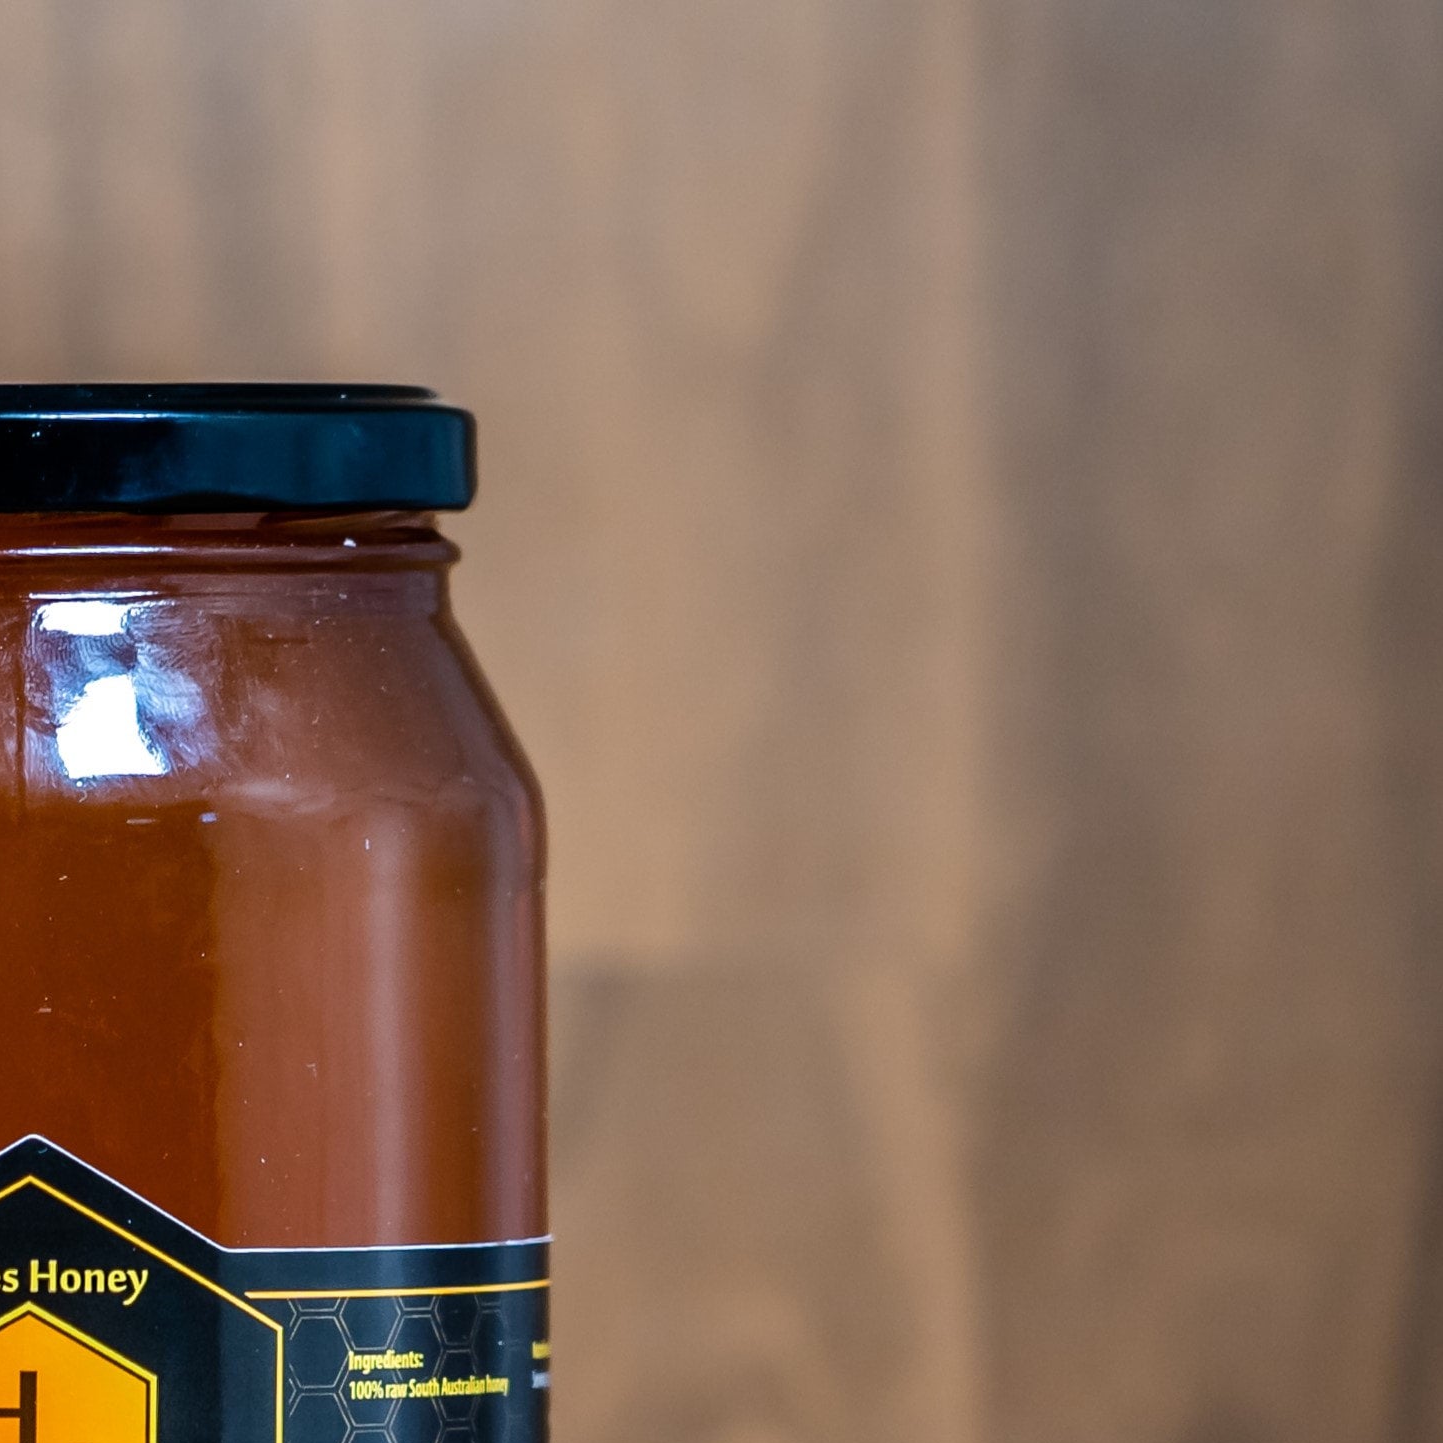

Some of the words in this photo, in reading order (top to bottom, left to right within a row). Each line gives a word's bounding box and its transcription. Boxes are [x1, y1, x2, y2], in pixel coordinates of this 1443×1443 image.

[29, 1259, 149, 1306] Honey
[348, 1349, 424, 1375] Ingredients:
[349, 1379, 384, 1400] 100%
[385, 1383, 408, 1399] raw
[409, 1377, 440, 1398] South
[441, 1375, 485, 1396] Australian
